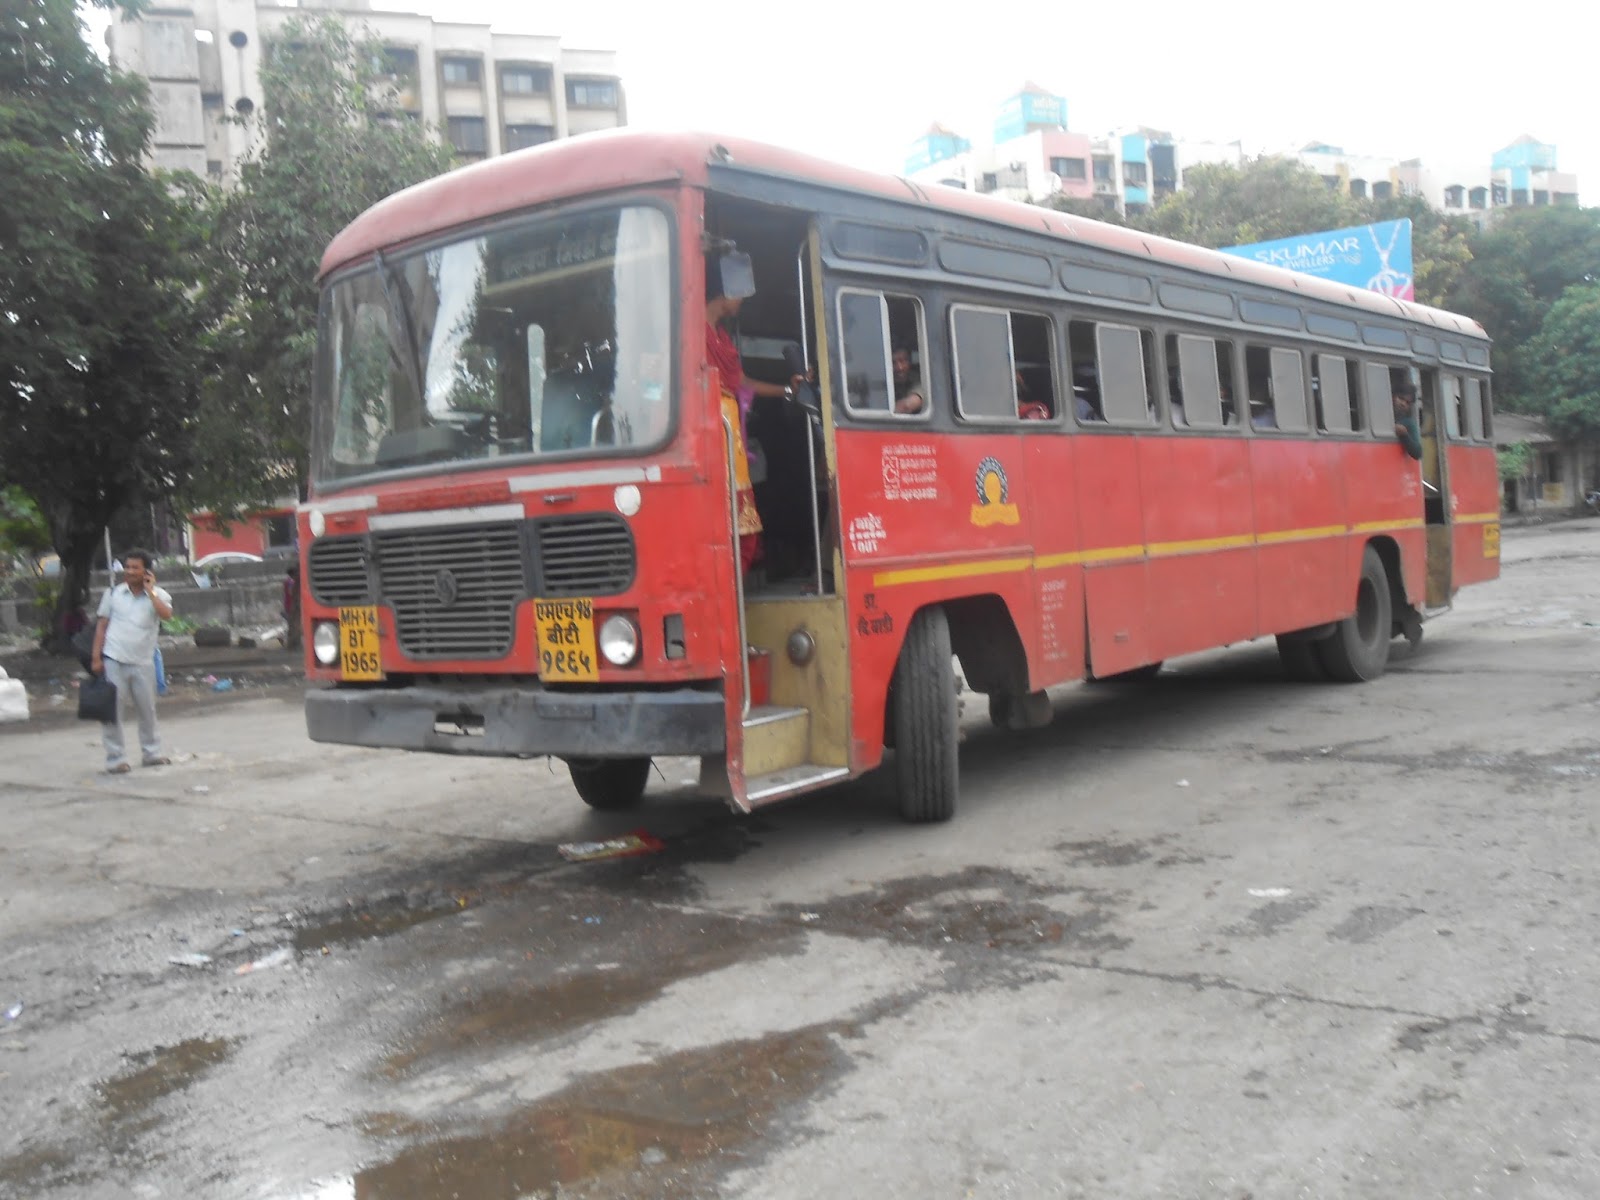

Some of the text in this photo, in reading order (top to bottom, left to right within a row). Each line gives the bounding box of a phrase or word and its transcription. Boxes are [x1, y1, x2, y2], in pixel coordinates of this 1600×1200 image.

[349, 629, 365, 648] BT
[343, 651, 378, 672] 1965
[542, 649, 591, 675] १९६५
